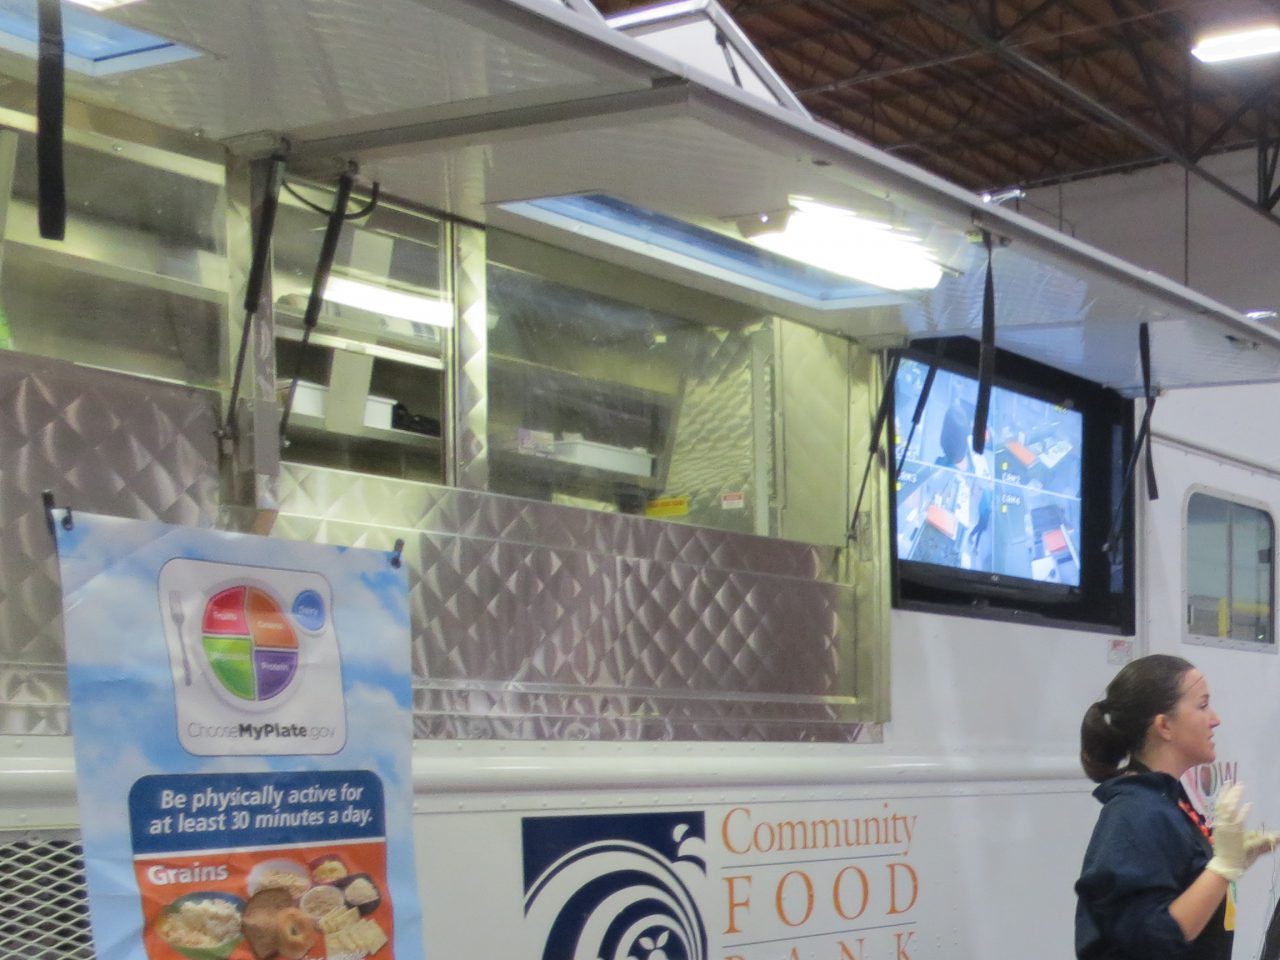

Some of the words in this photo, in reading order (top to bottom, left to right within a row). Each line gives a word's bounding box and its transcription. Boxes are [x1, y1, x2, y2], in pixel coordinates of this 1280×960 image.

[160, 789, 186, 809] Be
[192, 786, 284, 812] physically
[288, 784, 337, 805] active
[340, 782, 364, 801] for
[149, 816, 173, 834] at
[178, 813, 226, 833] least
[231, 811, 249, 830] 30
[255, 808, 324, 829] minutes
[328, 810, 339, 824] a
[341, 805, 373, 827] day.
[721, 802, 918, 857] Community
[148, 861, 229, 885] Grains
[721, 862, 919, 935] FOOD
